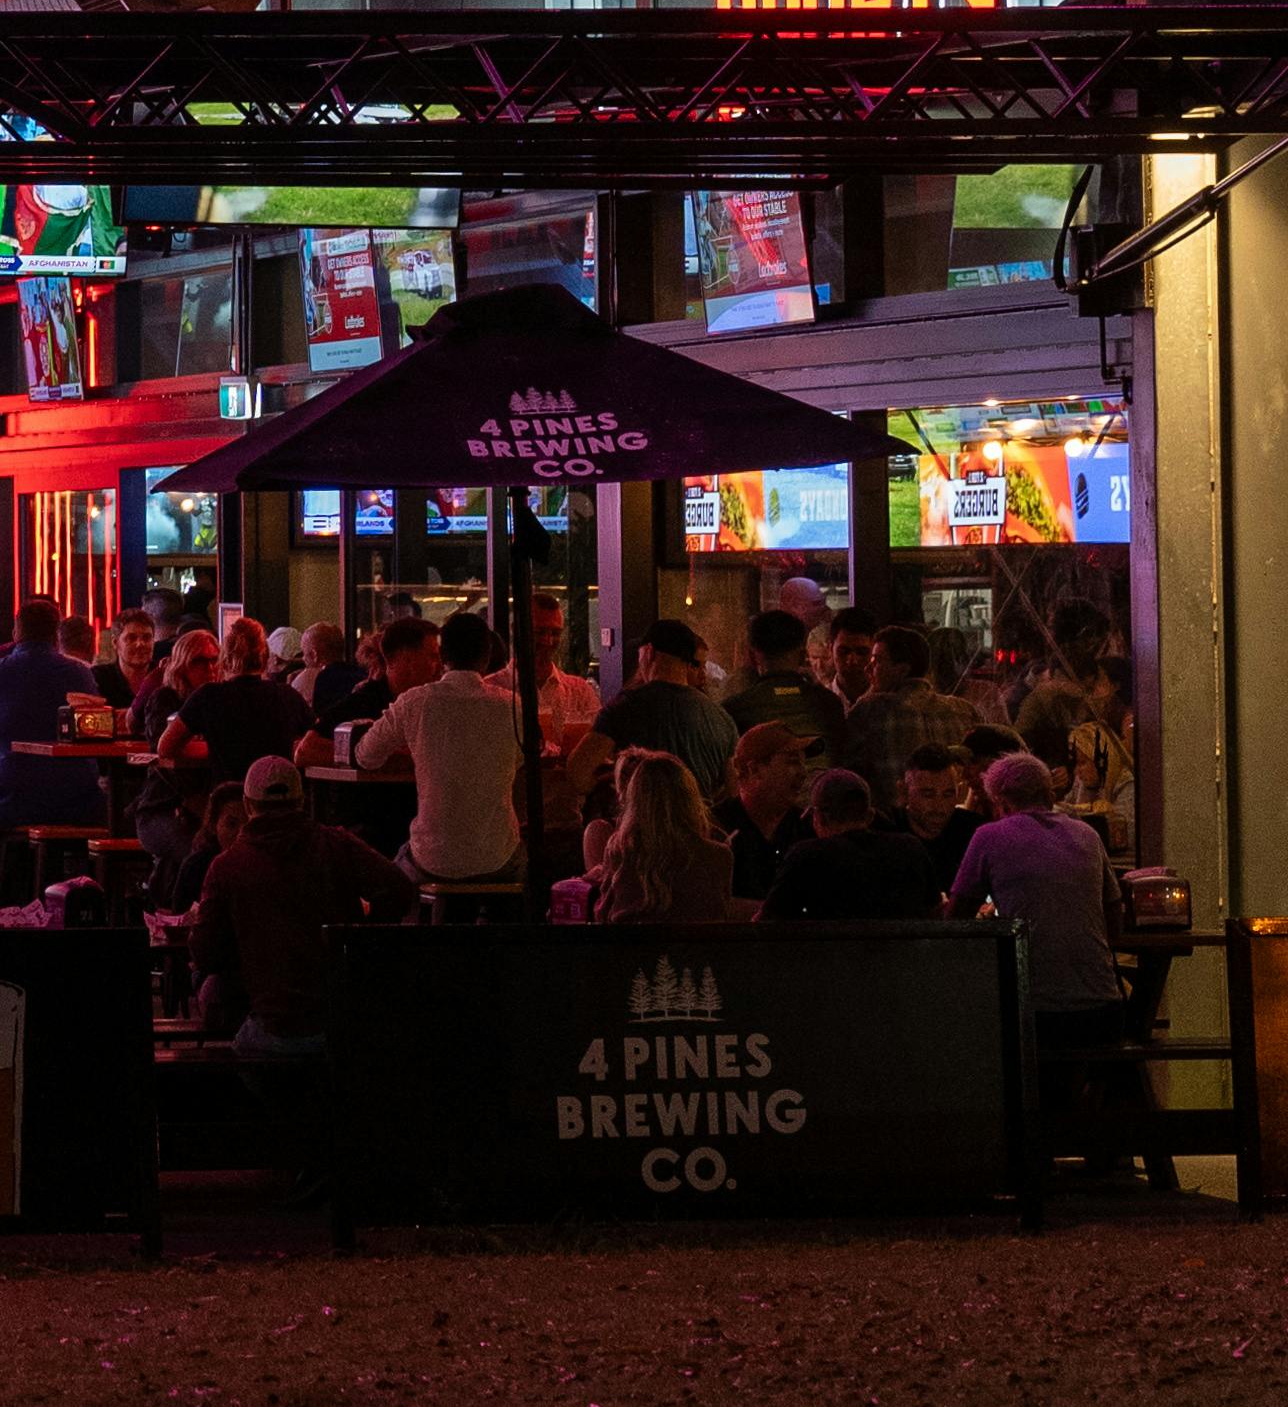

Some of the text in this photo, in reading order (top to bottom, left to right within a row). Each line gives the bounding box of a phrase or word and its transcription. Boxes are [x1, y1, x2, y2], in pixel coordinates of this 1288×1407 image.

[479, 412, 618, 436] 4 PINES
[467, 432, 648, 457] BREWING
[533, 458, 604, 477] CO.
[578, 1033, 773, 1081] 4 PINES
[556, 1088, 808, 1140] BREWING
[640, 1146, 738, 1193] CO.
